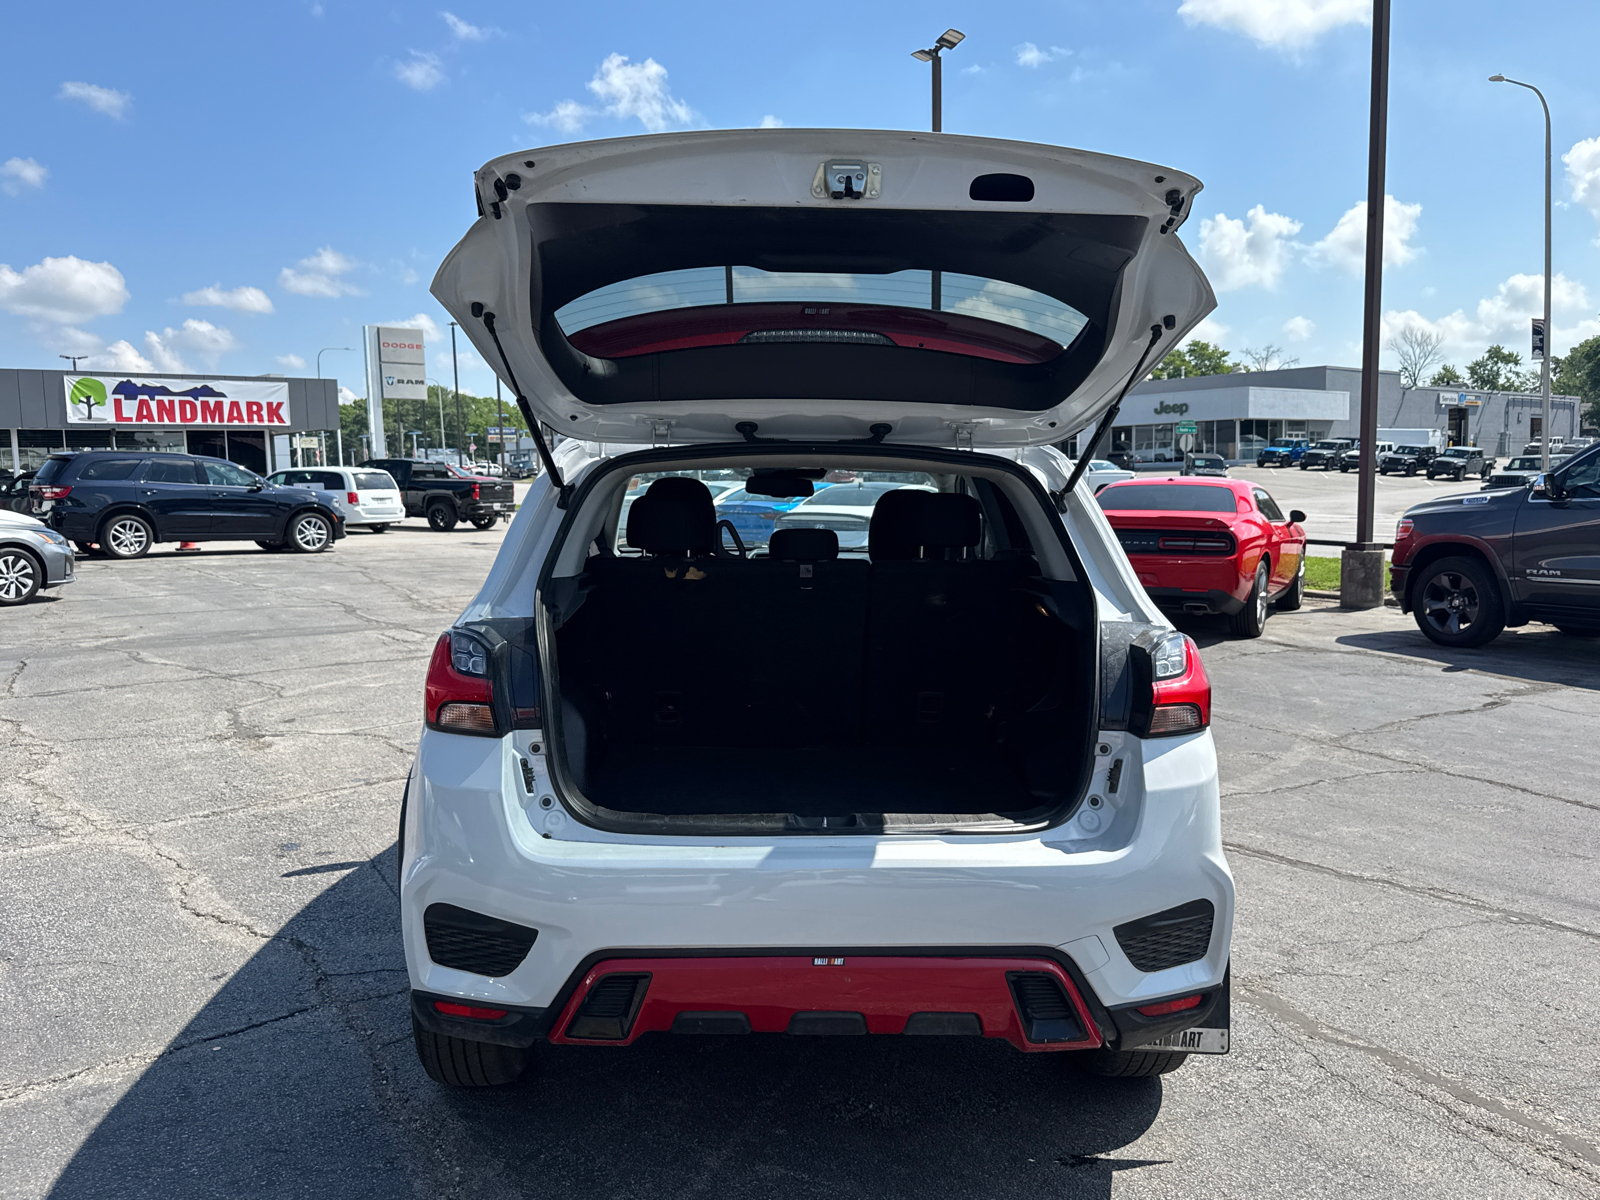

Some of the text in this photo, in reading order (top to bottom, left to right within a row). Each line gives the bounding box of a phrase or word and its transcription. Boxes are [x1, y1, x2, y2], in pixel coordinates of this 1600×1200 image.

[382, 341, 422, 350] DODGE
[396, 378, 425, 386] RAM
[1441, 395, 1457, 403] Service
[113, 398, 286, 424] LANDMARK
[1153, 400, 1189, 416] Jeep
[1525, 568, 1561, 576] RAM
